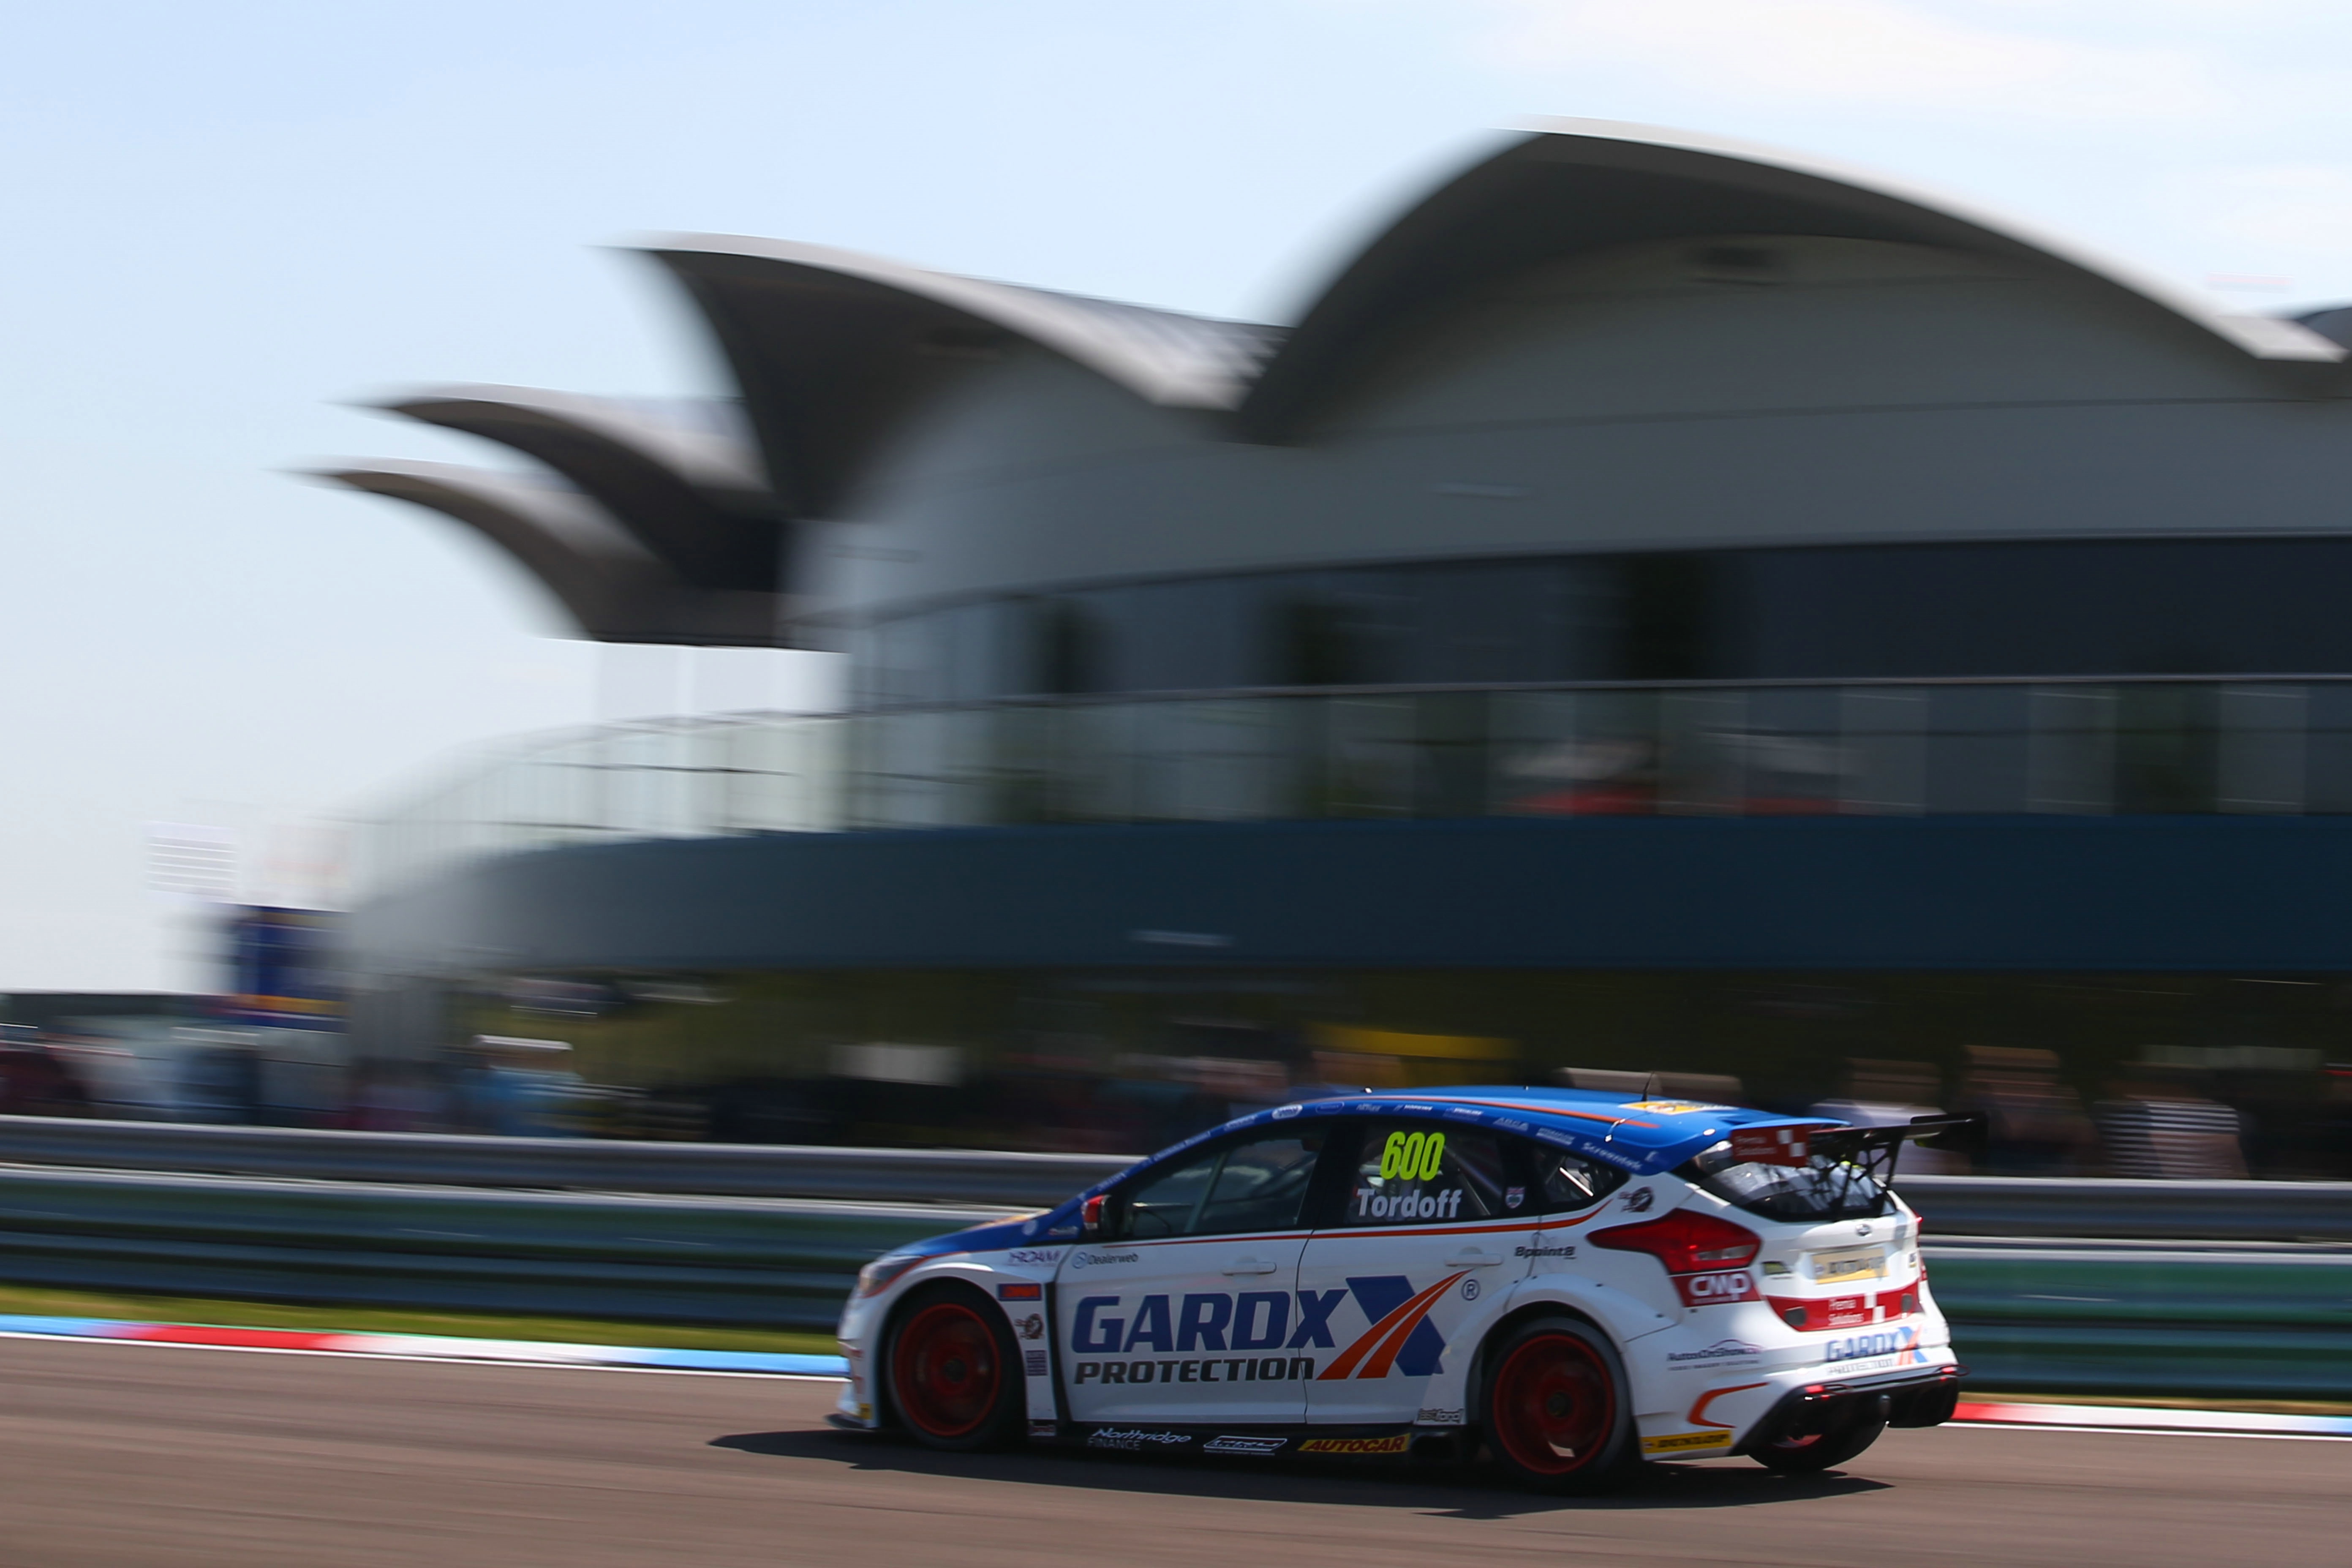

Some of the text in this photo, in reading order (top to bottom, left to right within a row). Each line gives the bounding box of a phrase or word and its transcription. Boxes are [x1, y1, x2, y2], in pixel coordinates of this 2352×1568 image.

[1380, 1131, 1445, 1181] 600
[1357, 1189, 1463, 1218] Tordoff
[1087, 1252, 1139, 1266] Dealerweb
[1071, 1289, 1349, 1353] GARDX
[1074, 1357, 1315, 1384] PROTECTION
[1086, 1437, 1141, 1451] FINANCE
[1092, 1427, 1192, 1444] Northridge
[1306, 1438, 1405, 1452] AUTOCAR
